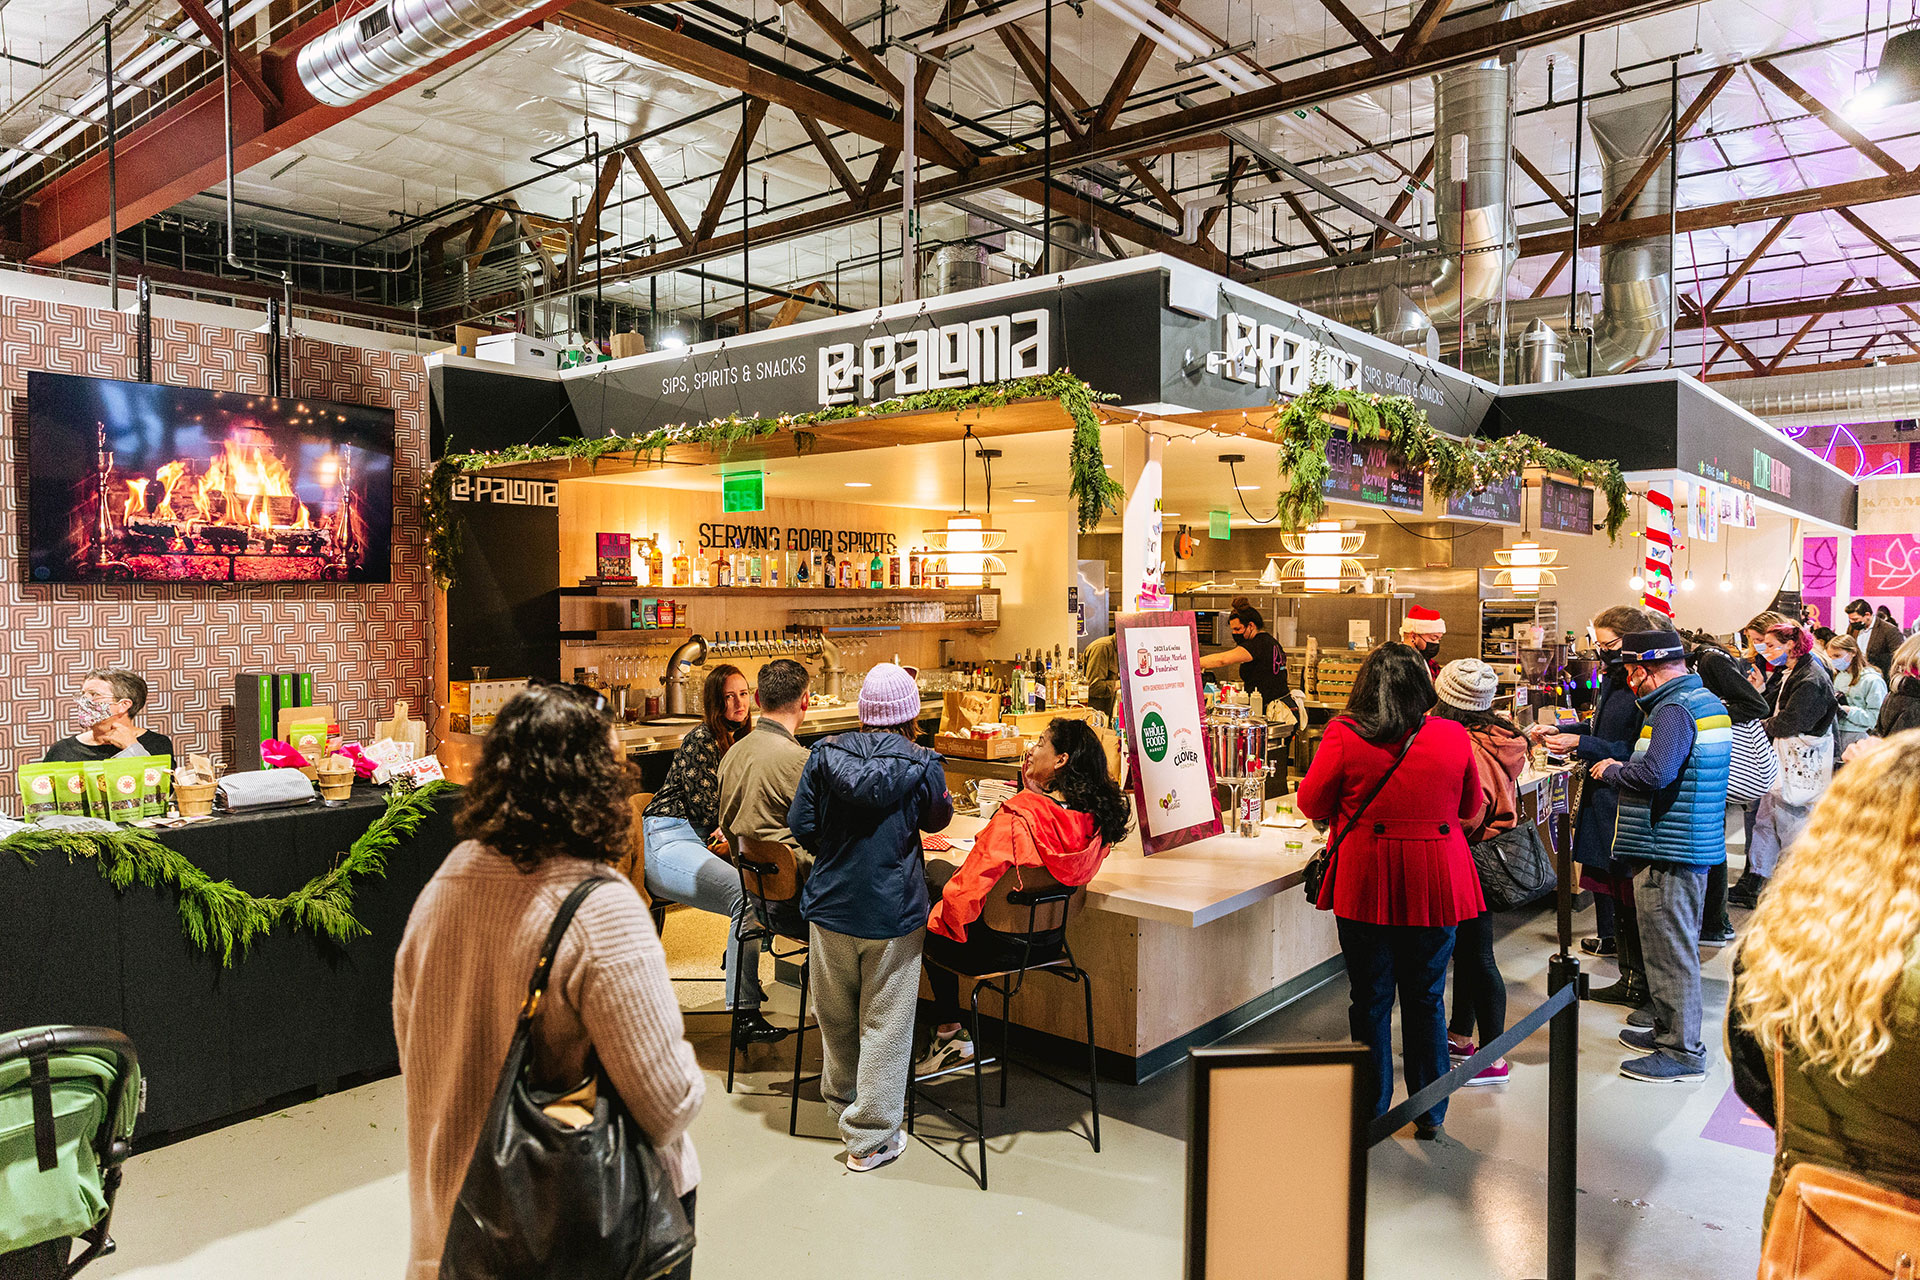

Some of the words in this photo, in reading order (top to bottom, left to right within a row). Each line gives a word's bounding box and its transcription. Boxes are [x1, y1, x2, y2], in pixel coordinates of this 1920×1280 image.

[693, 366, 738, 391] SPIRITS
[742, 364, 752, 382] &
[756, 355, 806, 381] SNACKS
[1385, 372, 1412, 396] SPIRITS
[1412, 381, 1419, 398] &
[1419, 383, 1444, 407] SNACKS
[1366, 447, 1388, 468] NOW
[1361, 465, 1388, 496] Serving
[698, 522, 780, 551] SERVING
[837, 530, 897, 555] SPIRITS
[1154, 653, 1171, 663] Holiday
[1172, 652, 1187, 661] Market
[1155, 664, 1179, 673] Fundraiser
[1143, 725, 1165, 737] WHOLE
[1145, 735, 1166, 748] FOODS
[1173, 750, 1198, 767] CLOVER
